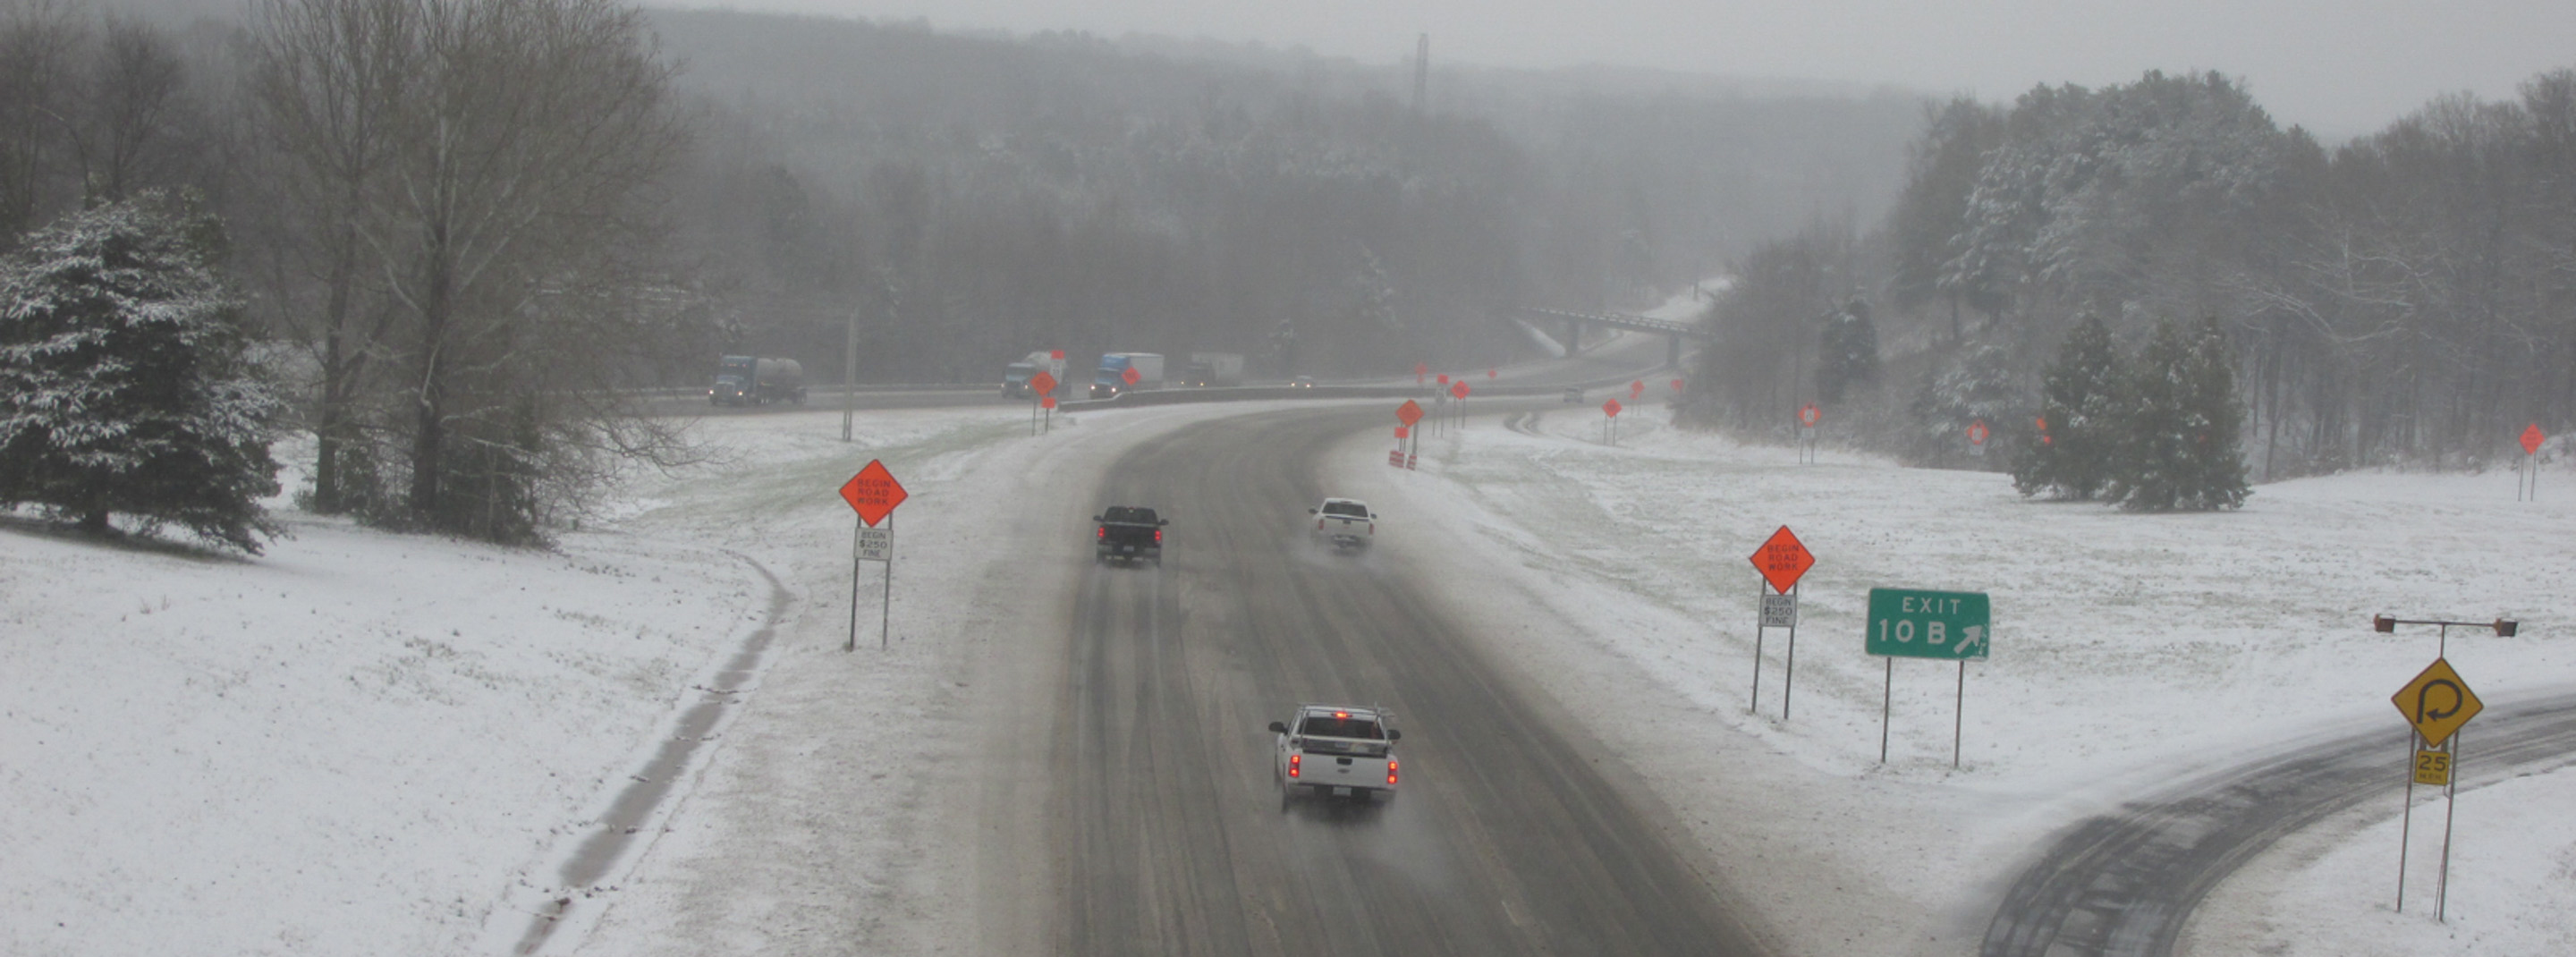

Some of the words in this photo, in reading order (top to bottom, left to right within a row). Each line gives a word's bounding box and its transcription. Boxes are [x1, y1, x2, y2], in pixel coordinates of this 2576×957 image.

[858, 478, 891, 487] BEGIN
[858, 487, 889, 496] ROAD
[858, 497, 889, 505] WORK
[861, 531, 886, 539] BEGIN
[860, 540, 887, 549] $250
[1767, 544, 1799, 552] BEGIN
[863, 549, 881, 557] FINE
[1768, 554, 1798, 562] ROAD
[1769, 563, 1798, 572] WORK
[1766, 597, 1792, 606] BEGIN
[1902, 597, 1961, 614] EXIT
[1764, 606, 1792, 616] $250
[1766, 616, 1790, 624] FINE
[1879, 618, 1915, 643] 10
[1927, 621, 1946, 644] B
[2419, 755, 2447, 772] 25
